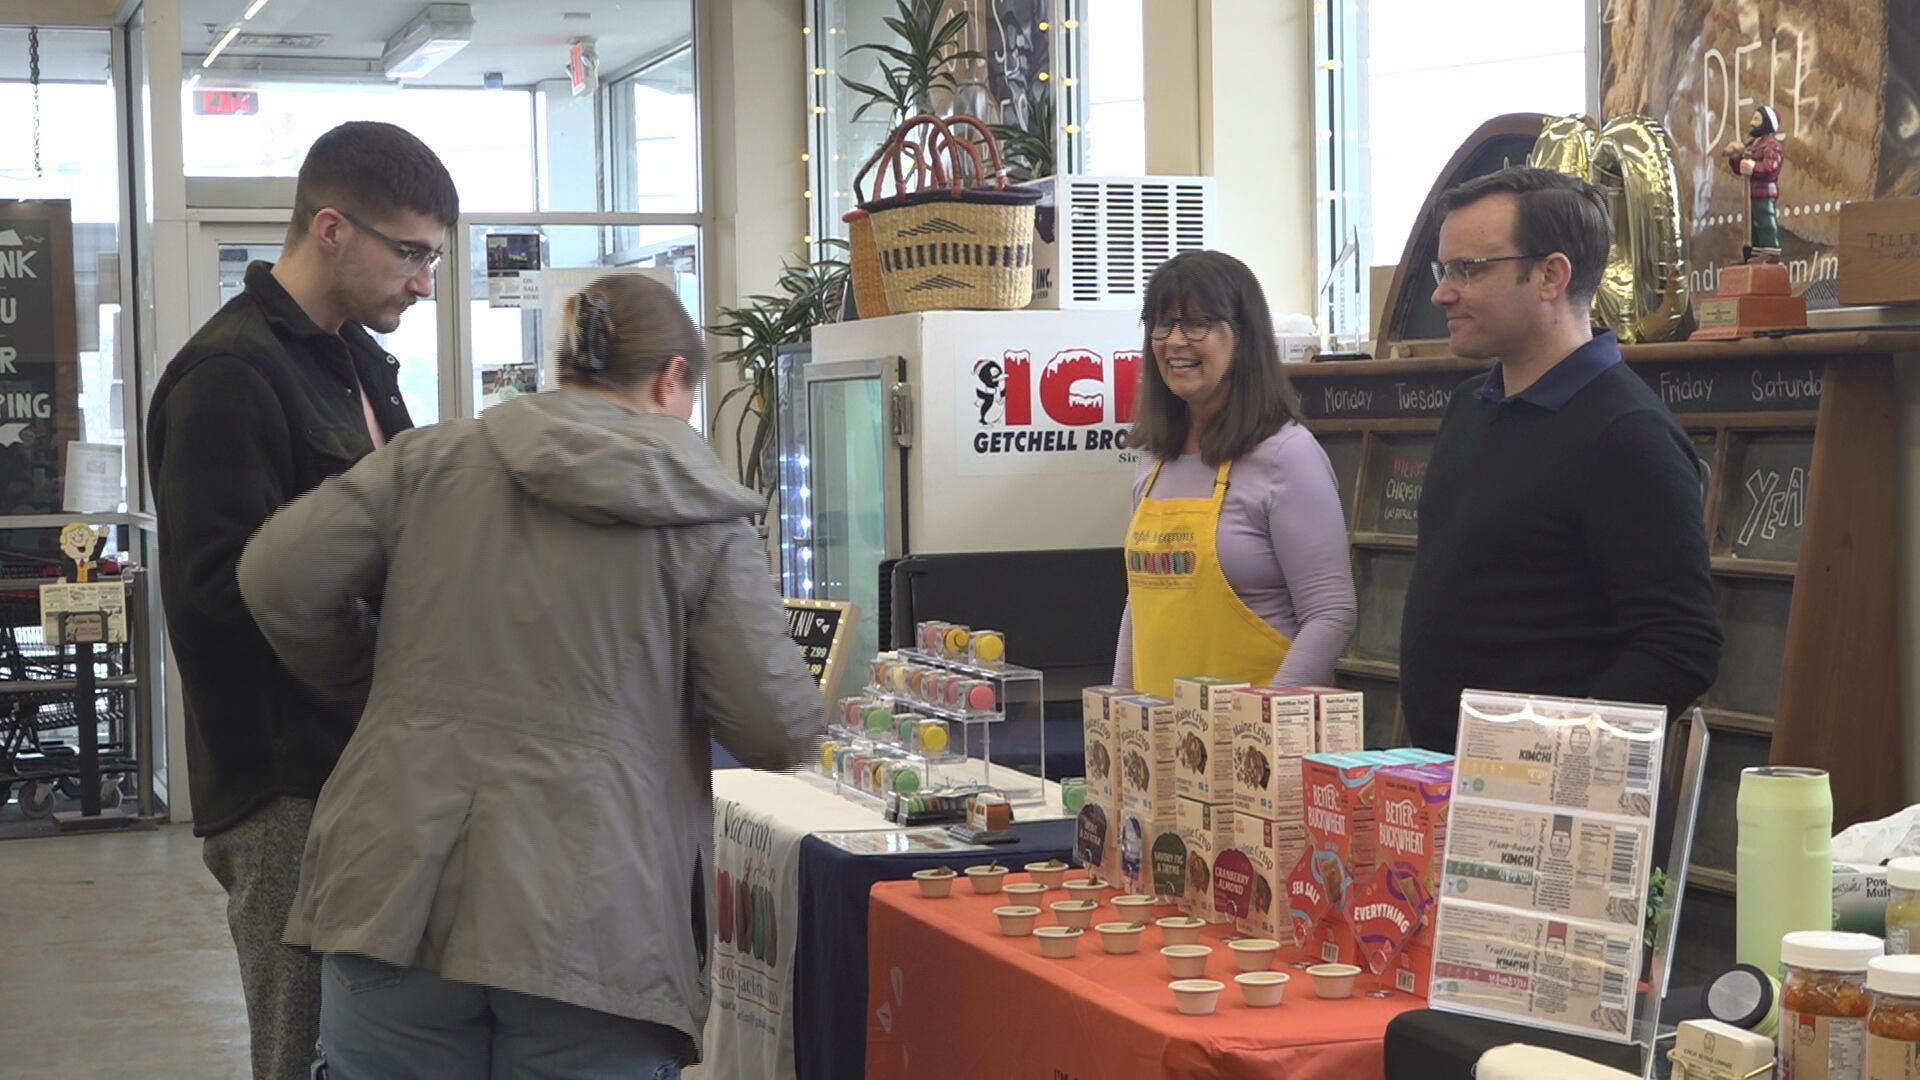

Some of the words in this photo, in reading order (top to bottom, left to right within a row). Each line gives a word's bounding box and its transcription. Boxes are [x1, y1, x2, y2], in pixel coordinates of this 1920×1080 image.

[1324, 386, 1373, 413] Monday
[1395, 382, 1452, 411] Tuesday
[1660, 371, 1714, 403] Friday
[974, 430, 1077, 454] GETCHELL
[1253, 720, 1272, 746] Crisp
[1519, 749, 1552, 763] KIMCHI
[1312, 784, 1341, 811] BETTER
[1307, 806, 1346, 836] BUCKWHEAT
[1385, 799, 1419, 829] BETTER
[1379, 823, 1425, 855] BUCKWHEAT
[1488, 839, 1536, 854] Plant-Based
[1501, 853, 1534, 868] KIMCHI
[1215, 866, 1249, 885] CRANBERRY
[1217, 879, 1244, 895] ALMOND
[1292, 881, 1304, 895] SEA
[1305, 882, 1320, 905] SALT
[1354, 903, 1410, 933] EVERYTHING
[1485, 943, 1530, 959] Traditional
[1496, 957, 1530, 970] KIMCHI
